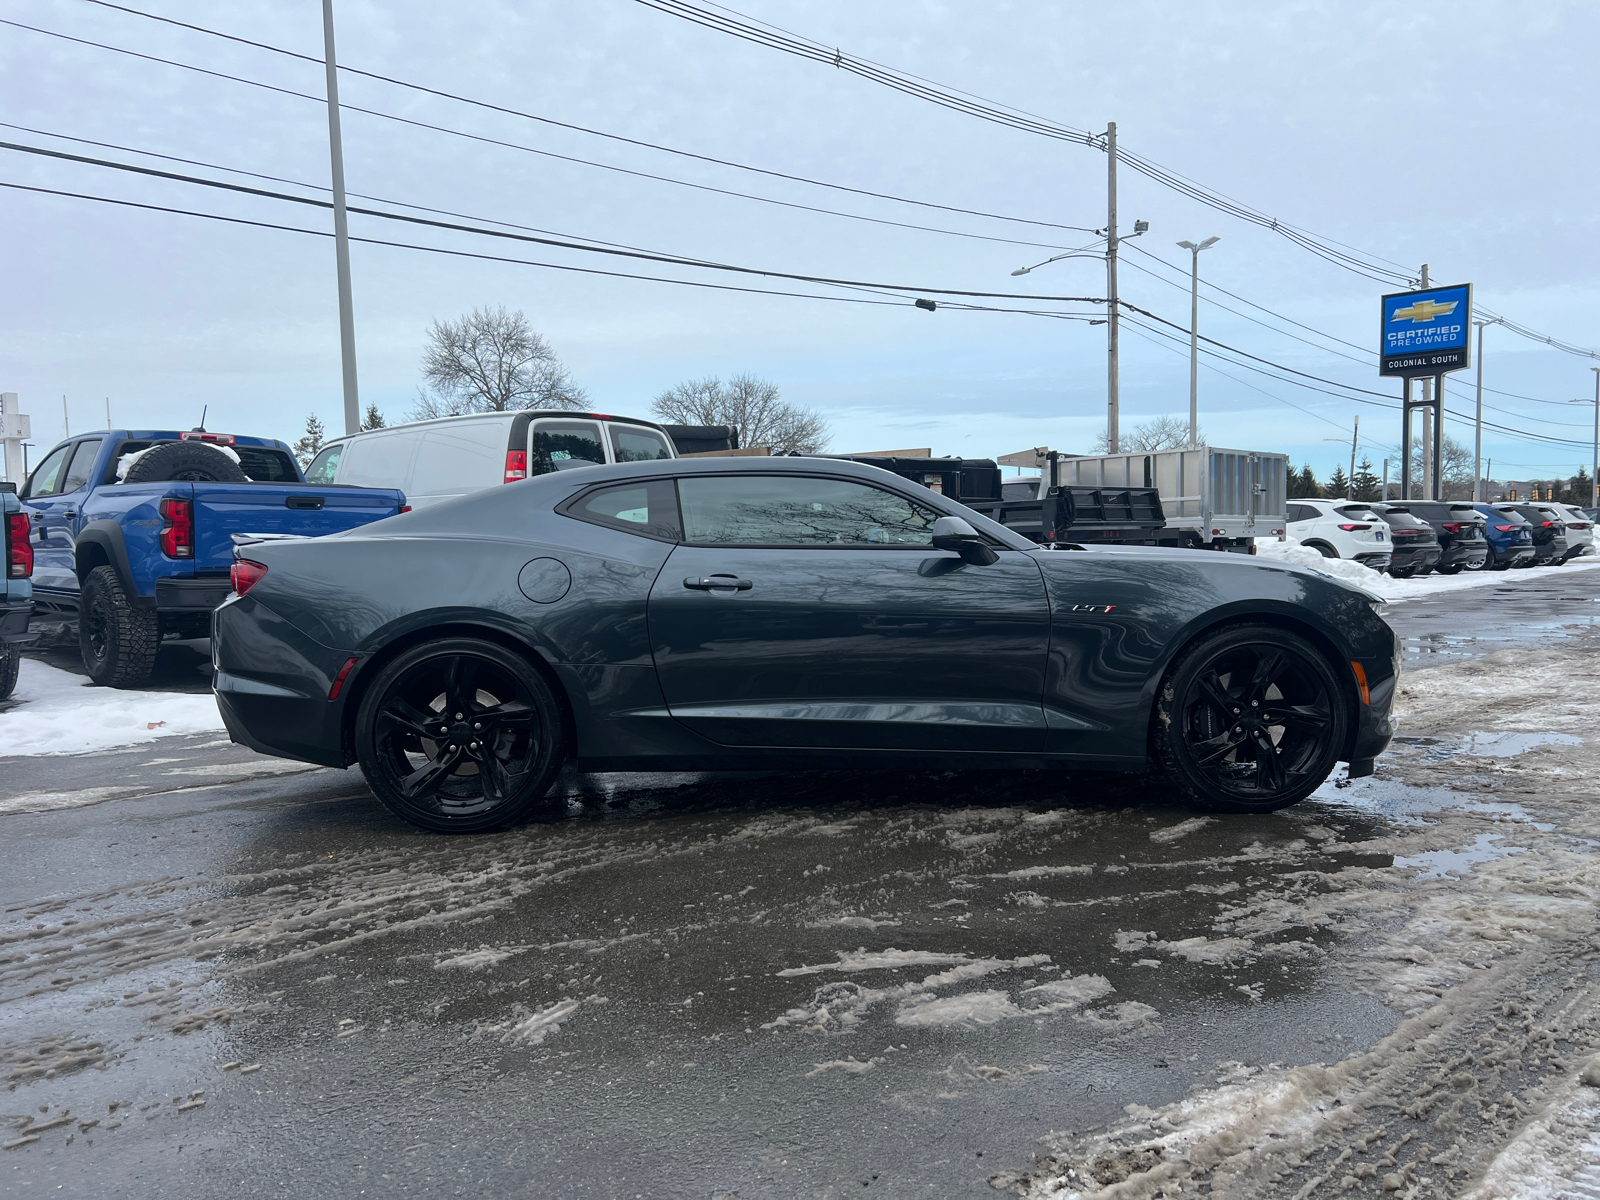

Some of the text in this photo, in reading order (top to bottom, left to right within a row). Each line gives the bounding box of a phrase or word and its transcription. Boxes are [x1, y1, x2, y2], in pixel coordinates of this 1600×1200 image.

[1387, 325, 1461, 340] CERTIFIED
[1390, 333, 1457, 348] PRE-OWNED
[1388, 354, 1458, 368] COLONIAL SOUTH
